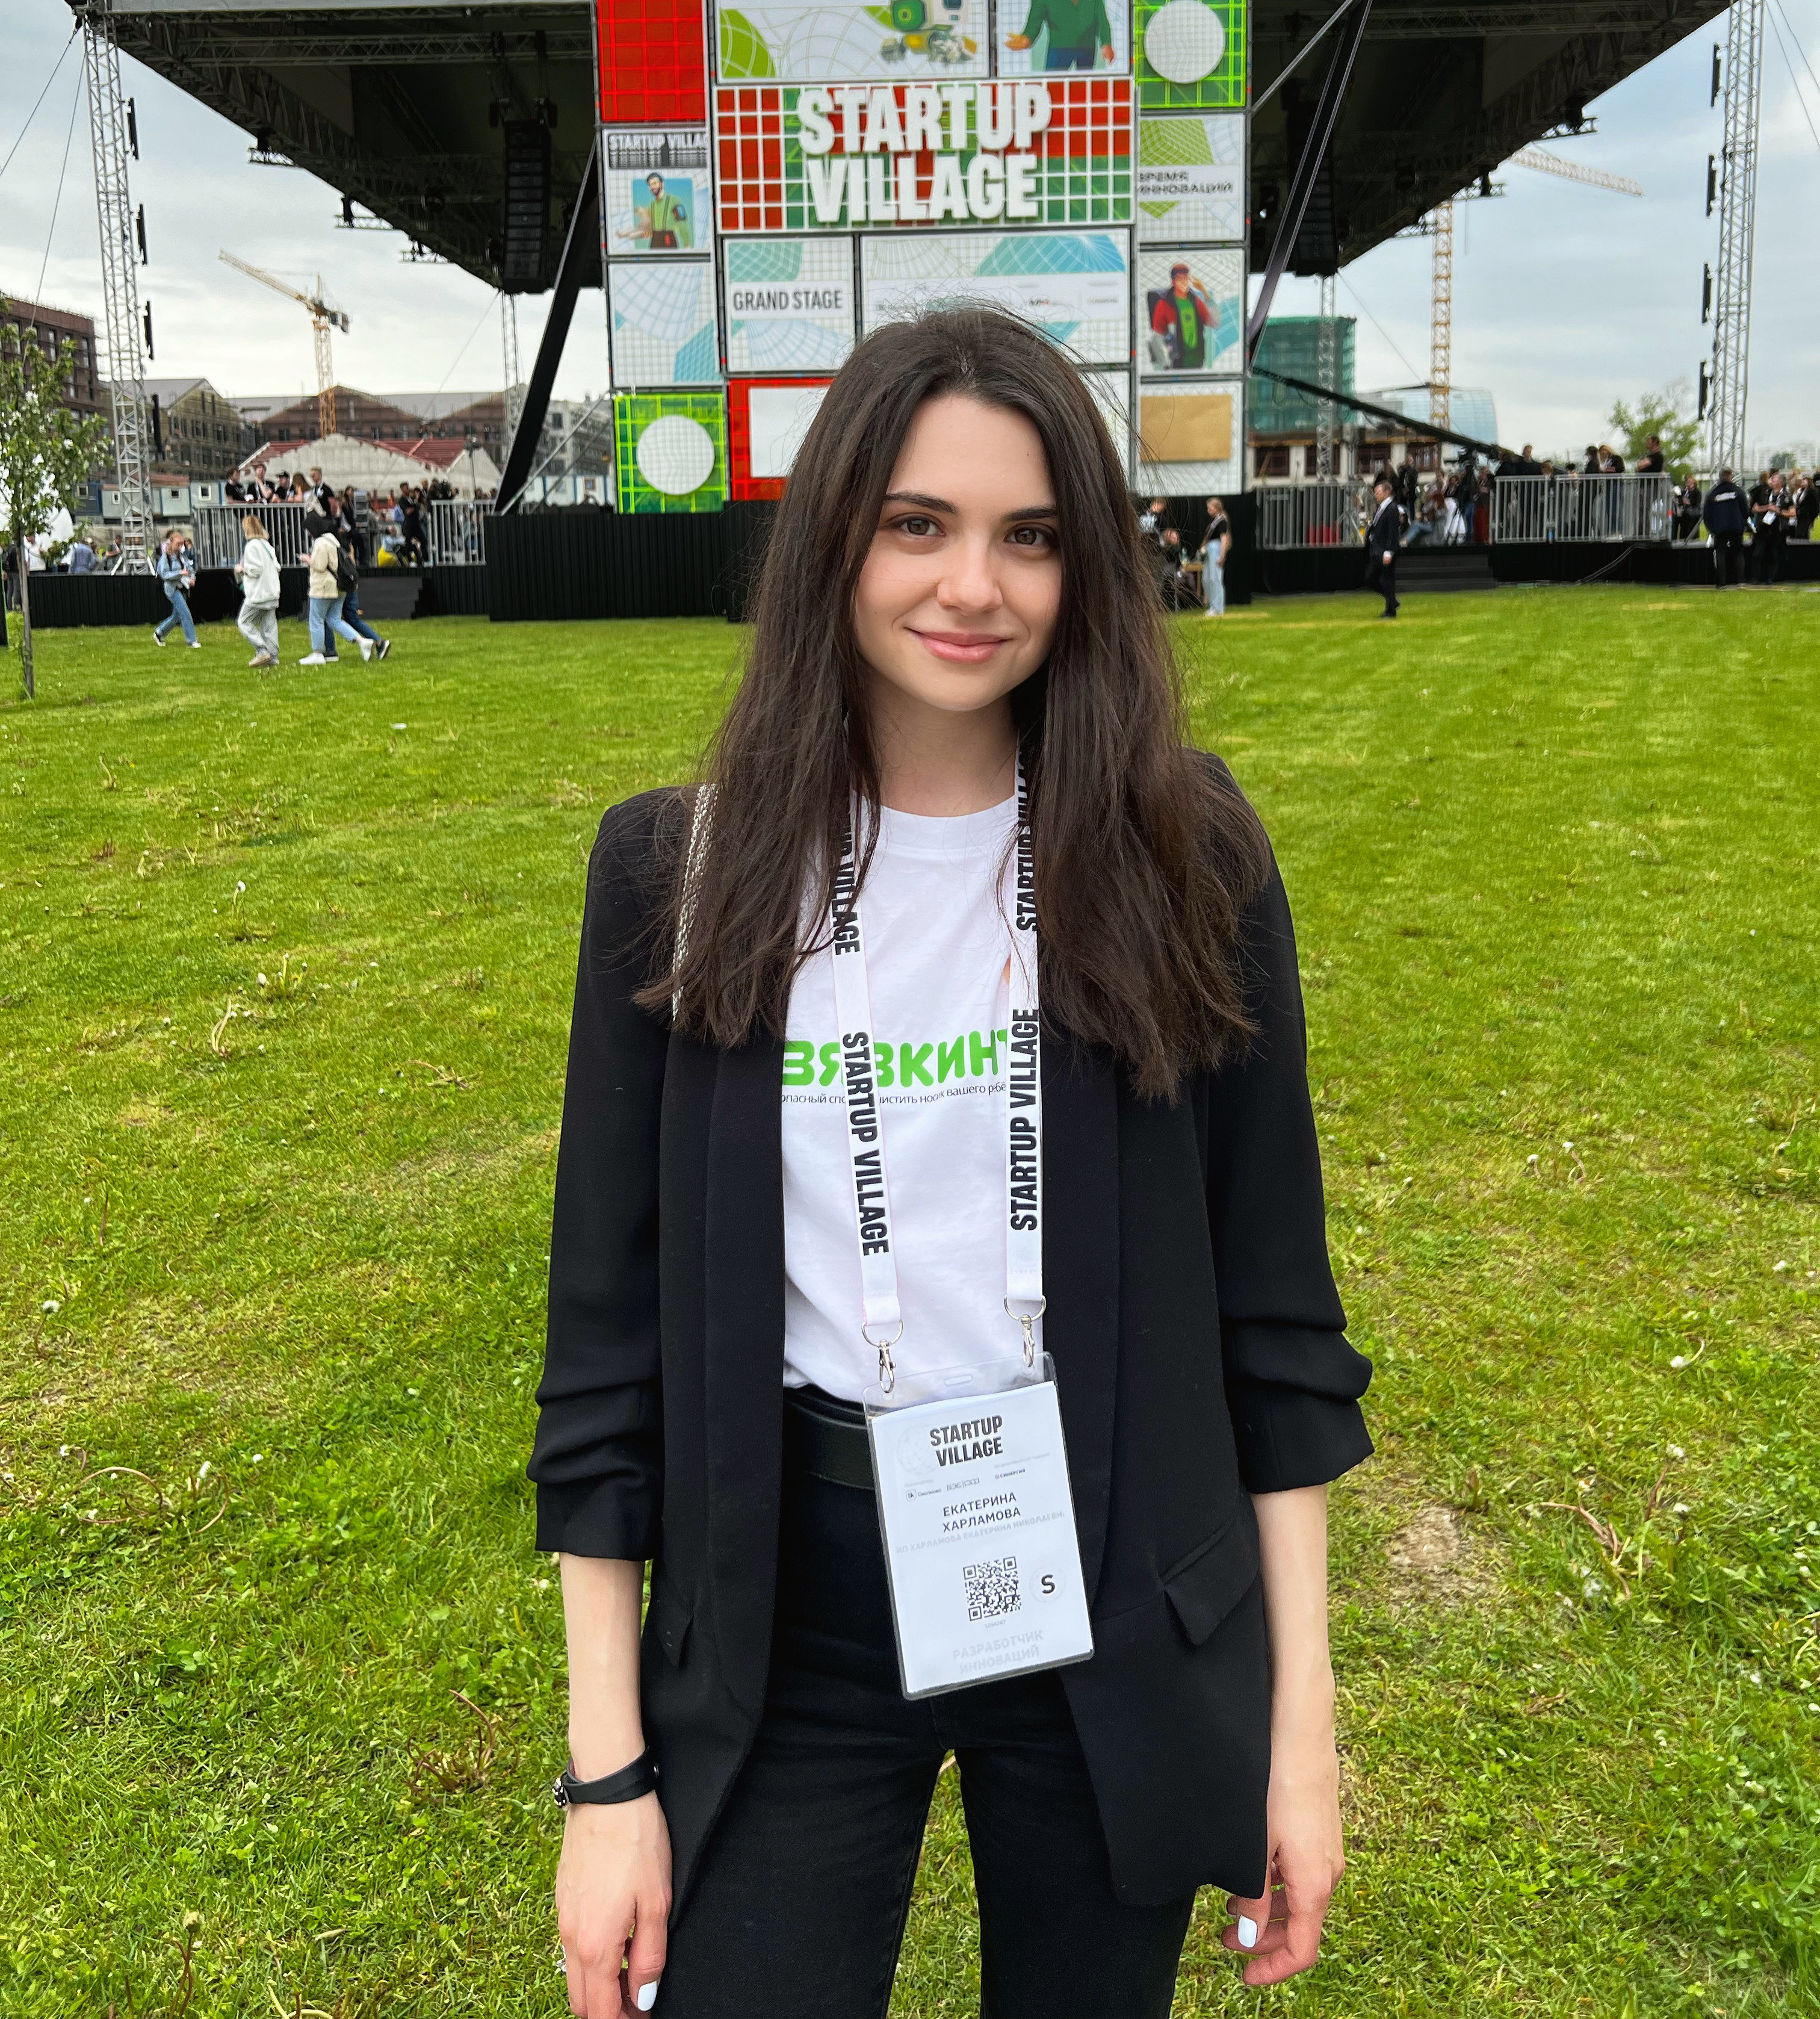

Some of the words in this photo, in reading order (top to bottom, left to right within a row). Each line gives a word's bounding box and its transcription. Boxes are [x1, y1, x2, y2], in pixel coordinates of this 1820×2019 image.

[796, 84, 1051, 154] STARTUP
[609, 134, 666, 150] STARTUP
[808, 153, 1038, 222] VILLAGE
[733, 291, 789, 311] GRAND
[792, 290, 843, 310] STAGE
[1010, 1009, 1038, 1108] VILLAGE
[843, 1031, 878, 1143] STARTUP
[947, 1085, 986, 1096] вашего
[1011, 1117, 1038, 1230] STARTUP
[854, 1149, 889, 1256] VILLAGE
[930, 1415, 1003, 1446] STARTUP
[936, 1436, 1003, 1467] VILLAGE
[942, 1507, 1021, 1533] ХАРЛАМОВА
[943, 1492, 1017, 1517] ЕКАТЕРИНА
[910, 1534, 961, 1552] ХАРЛАМОВА
[963, 1523, 1011, 1539] ЕКАТЕРИНА
[1013, 1511, 1065, 1528] НИКОЛАЕВН
[1041, 1574, 1055, 1593] S
[953, 1630, 1043, 1660] РАЗРАБОТЧИК
[960, 1644, 1040, 1673] ИННОВАЦИЙ
